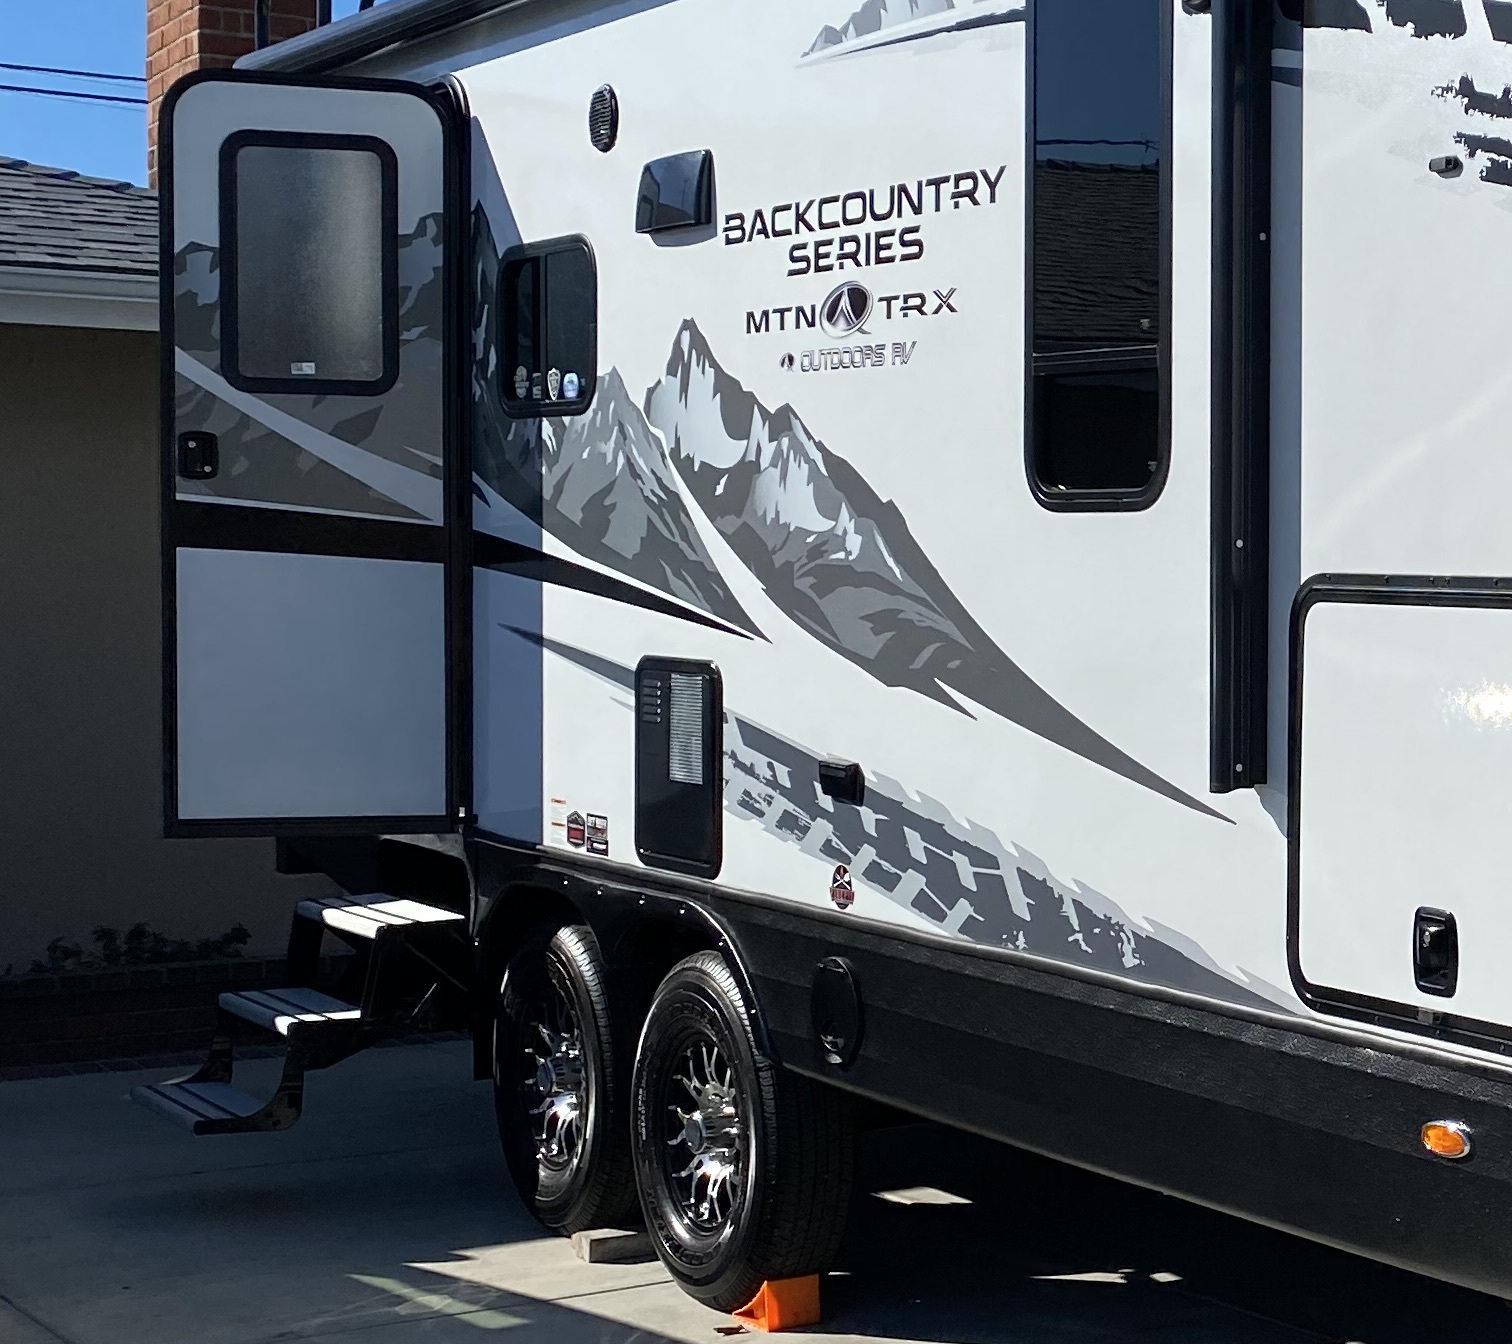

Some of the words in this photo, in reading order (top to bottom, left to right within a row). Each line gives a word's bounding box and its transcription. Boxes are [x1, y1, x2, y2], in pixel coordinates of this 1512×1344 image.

[722, 164, 1008, 246] BACKCOUNTRY
[786, 224, 925, 277] SERIES
[746, 304, 817, 335] MTN
[877, 287, 958, 320] TRX
[801, 343, 886, 372] OUTDOORS
[891, 340, 917, 365] RV
